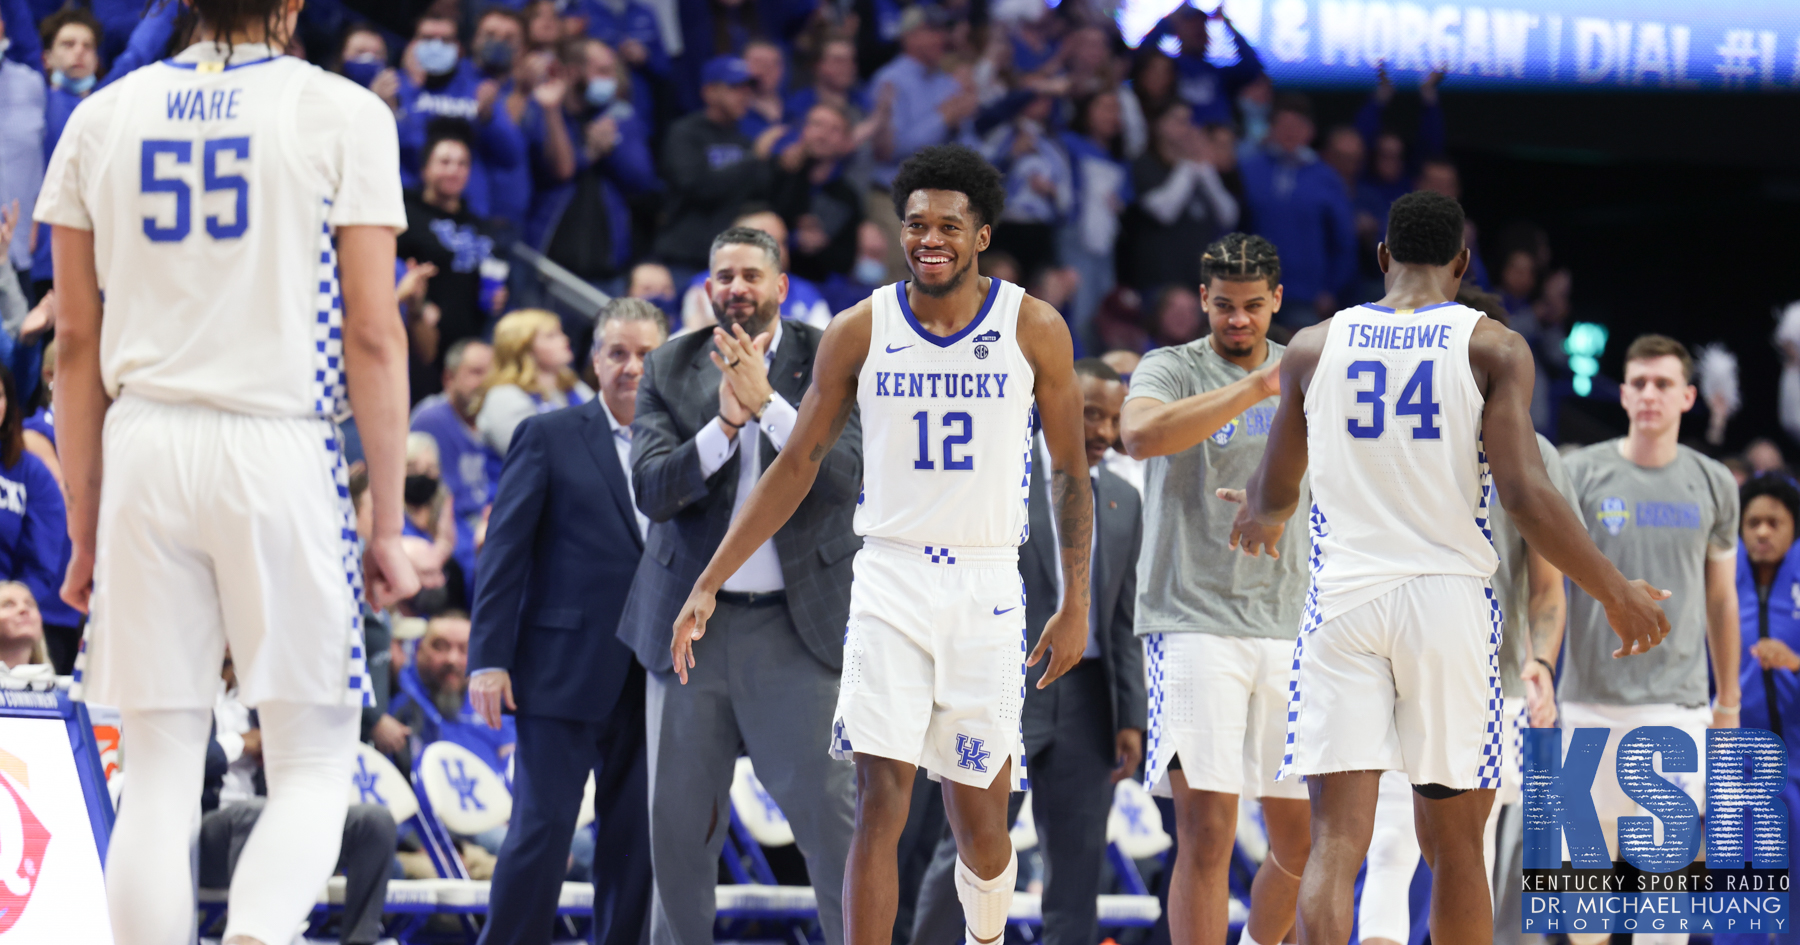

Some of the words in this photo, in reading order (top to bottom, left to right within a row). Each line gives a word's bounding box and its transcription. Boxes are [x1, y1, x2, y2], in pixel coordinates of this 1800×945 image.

[1572, 16, 1699, 88] DIAL
[1714, 28, 1800, 90] #L
[166, 88, 243, 121] WARE
[140, 136, 250, 243] 55
[974, 344, 989, 360] SEC
[1348, 324, 1452, 350] TSHIEBWE
[876, 371, 1009, 398] KENTUCKY
[1345, 359, 1443, 441] 34
[1245, 414, 1274, 428] CRE
[911, 409, 975, 472] 12
[955, 732, 991, 773] UK
